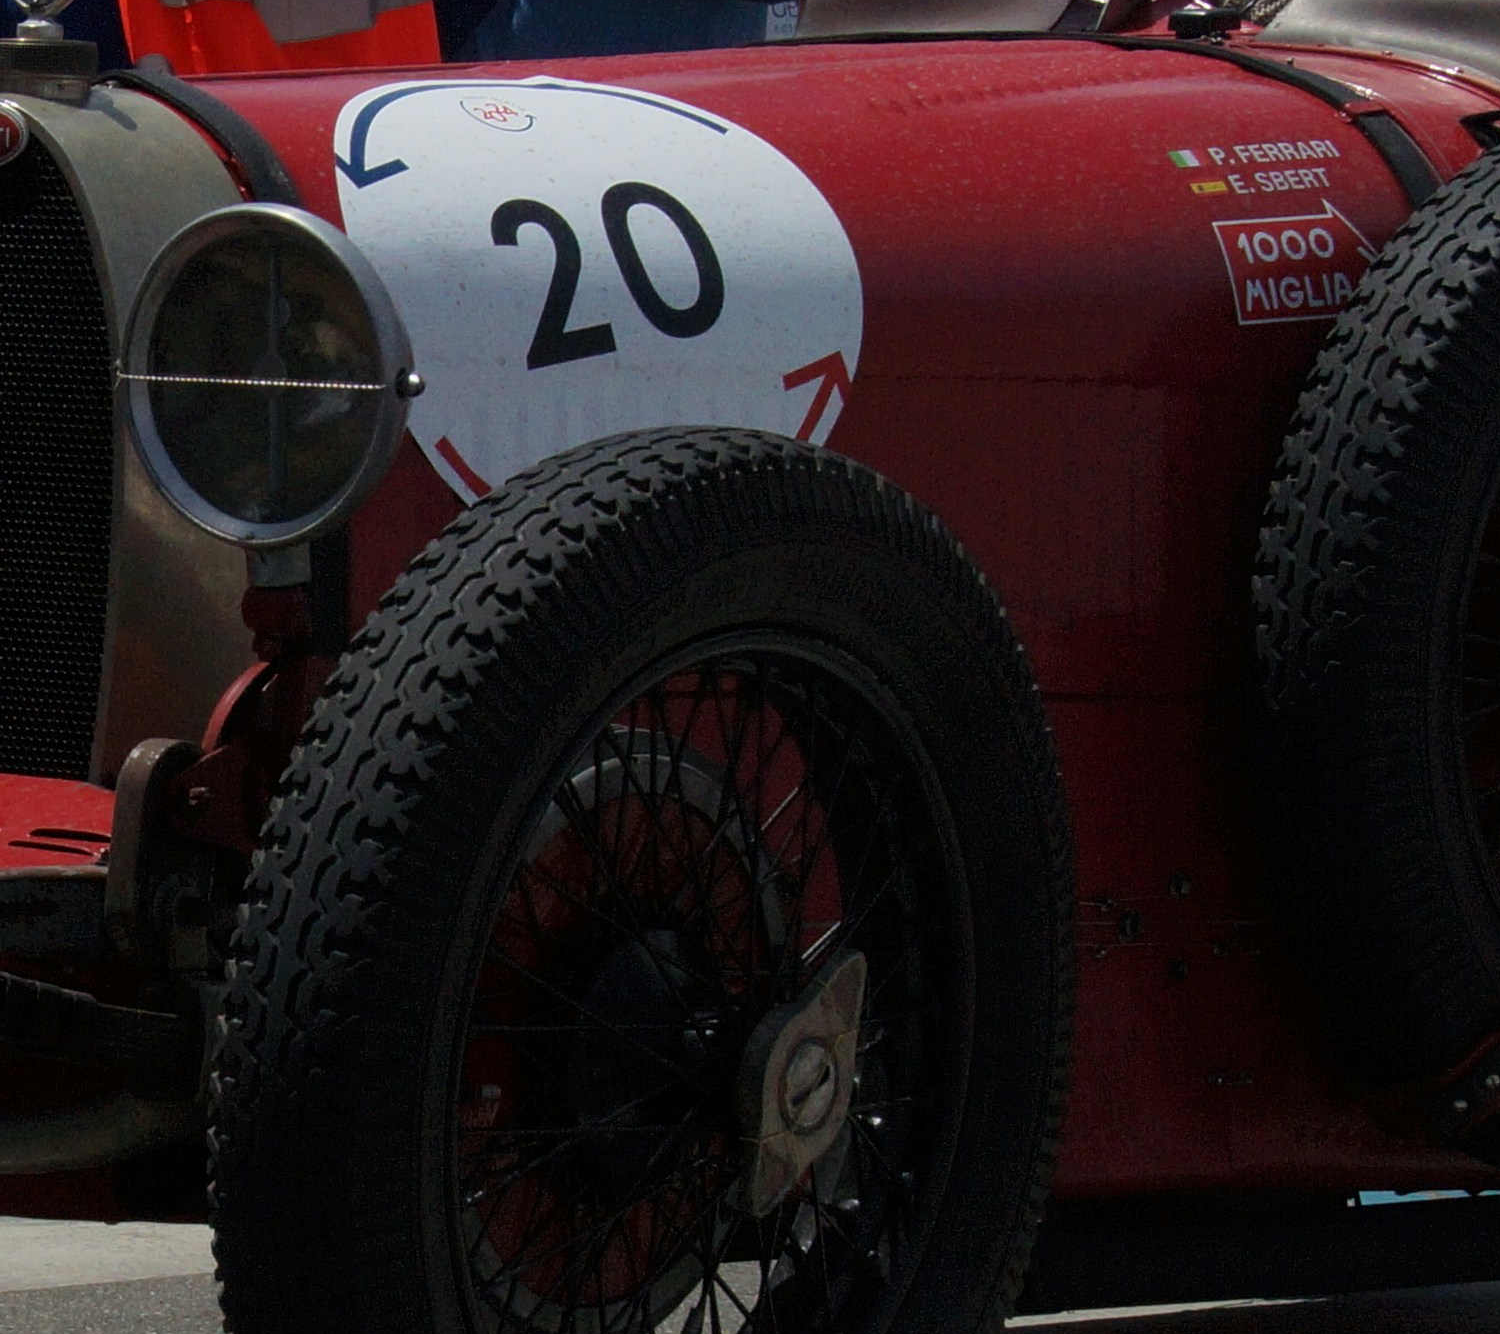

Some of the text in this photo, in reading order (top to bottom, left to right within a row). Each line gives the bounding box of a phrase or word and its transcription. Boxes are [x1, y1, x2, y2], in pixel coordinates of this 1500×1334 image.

[1254, 168, 1330, 192] SBERT
[1237, 227, 1335, 264] 1000
[491, 182, 724, 370] 20
[1245, 272, 1355, 313] MIGLIA
